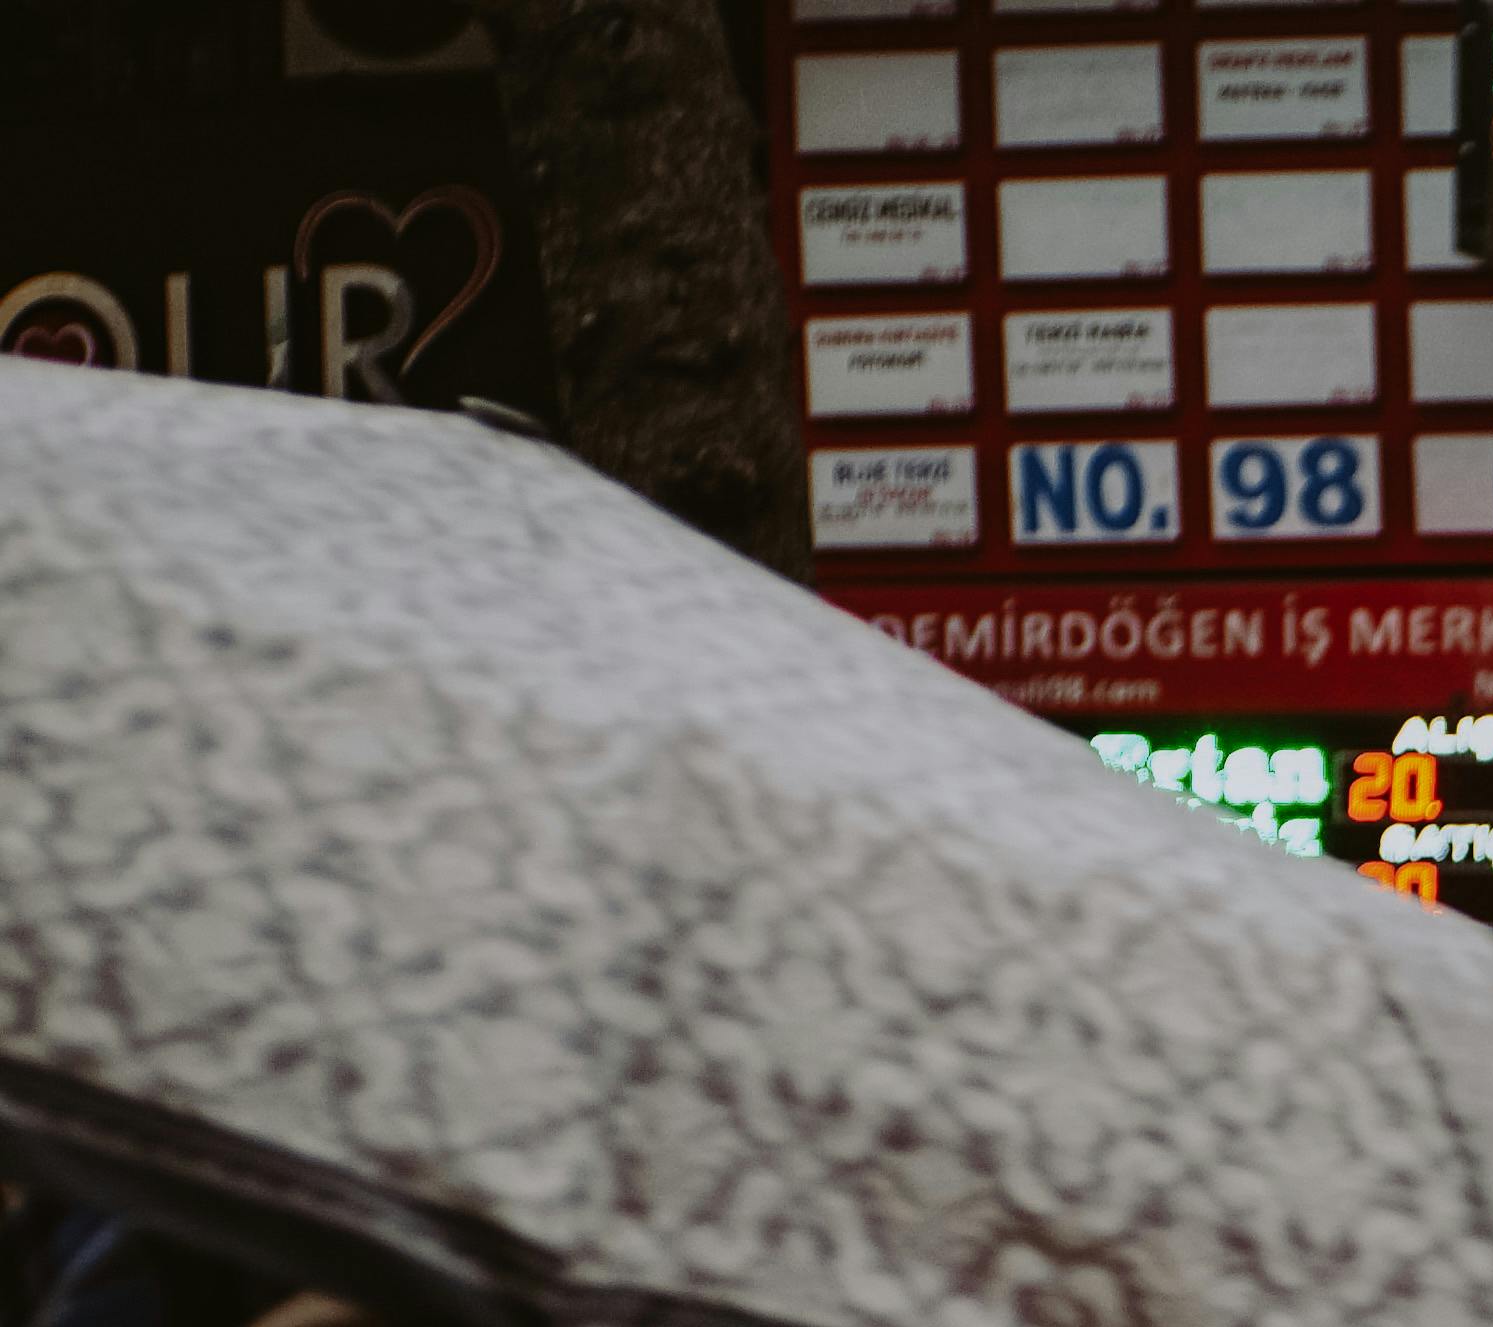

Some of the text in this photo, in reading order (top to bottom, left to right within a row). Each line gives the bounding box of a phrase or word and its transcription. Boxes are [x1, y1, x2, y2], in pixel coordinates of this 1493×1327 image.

[1017, 436, 1364, 534] NO. 98
[1283, 592, 1331, 668] İŞ
